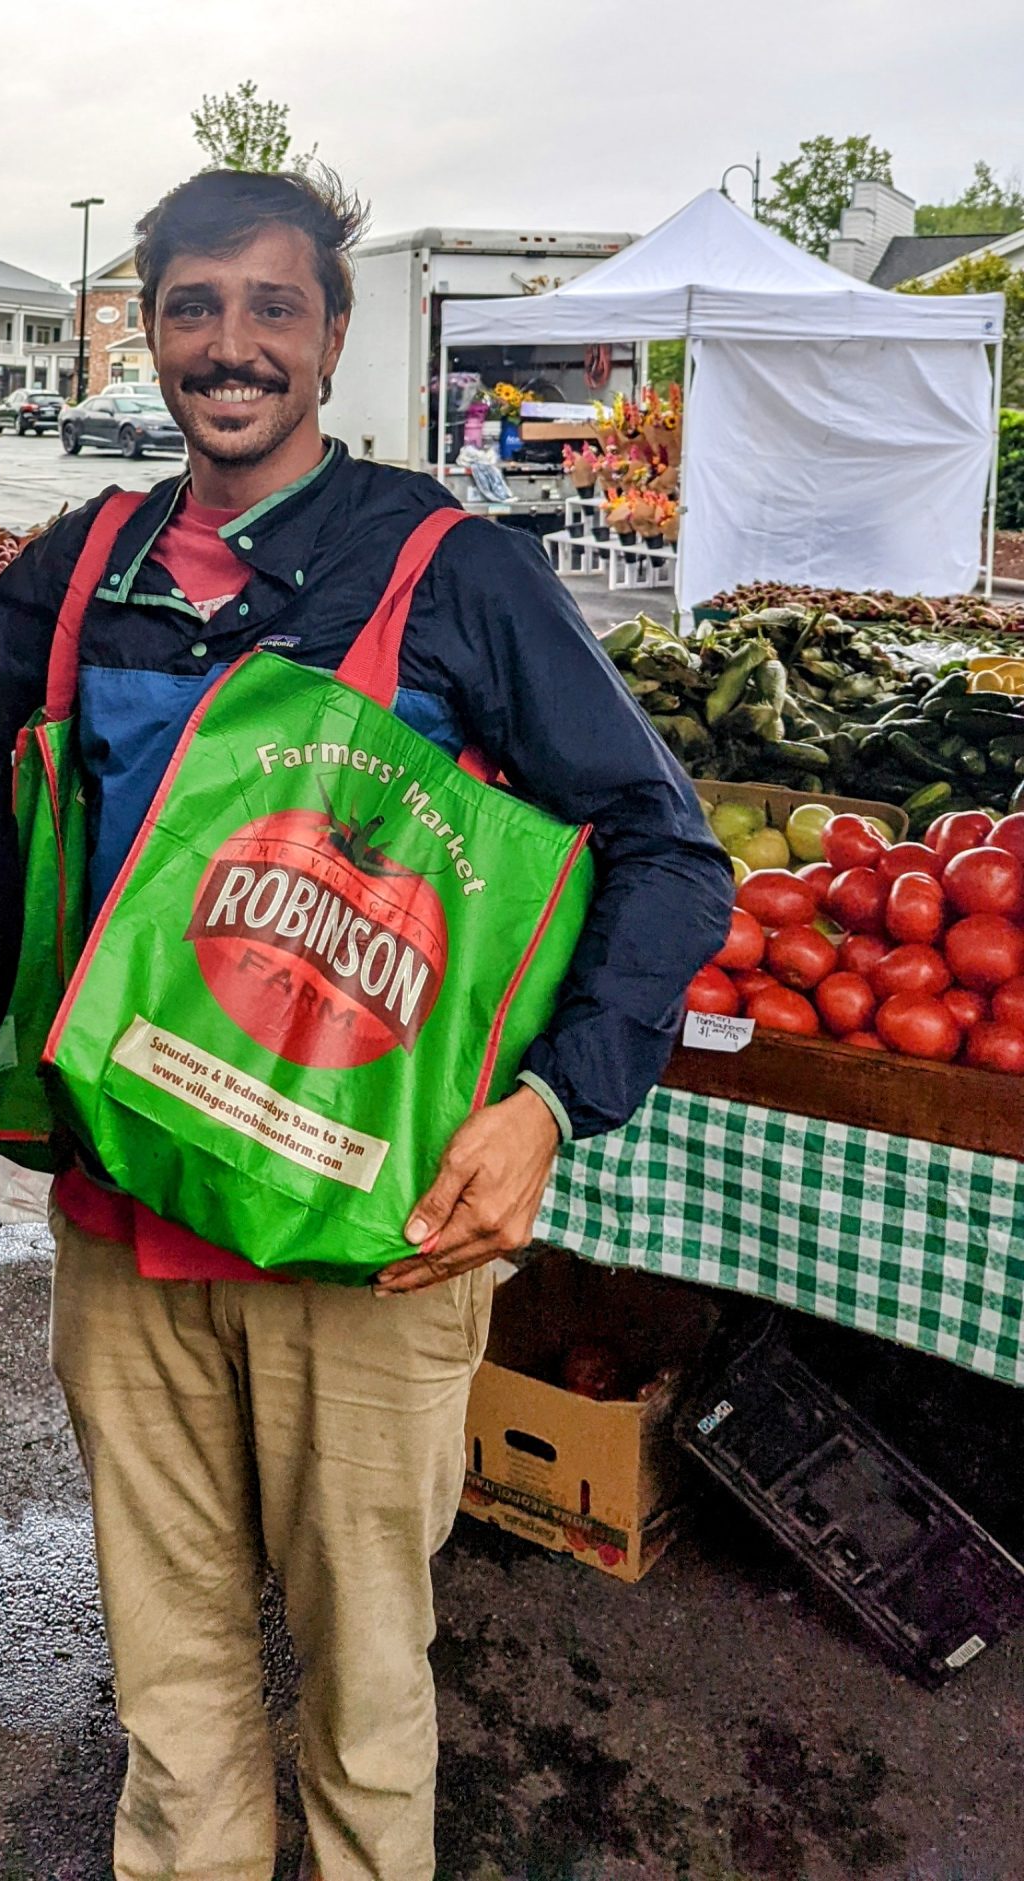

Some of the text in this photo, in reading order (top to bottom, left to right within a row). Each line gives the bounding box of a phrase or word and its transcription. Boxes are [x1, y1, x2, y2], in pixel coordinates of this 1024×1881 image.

[260, 639, 294, 648] atagonia
[255, 742, 488, 897] Farmers' Market
[205, 866, 430, 1027] ROBINSON
[238, 844, 439, 955] THE VILLAGE AT
[237, 948, 358, 1029] FARM
[150, 1036, 365, 1156] Saturdays & Wednesdays 9am to 3pm
[152, 1063, 342, 1171] www.villageatrobinsonfarm.com
